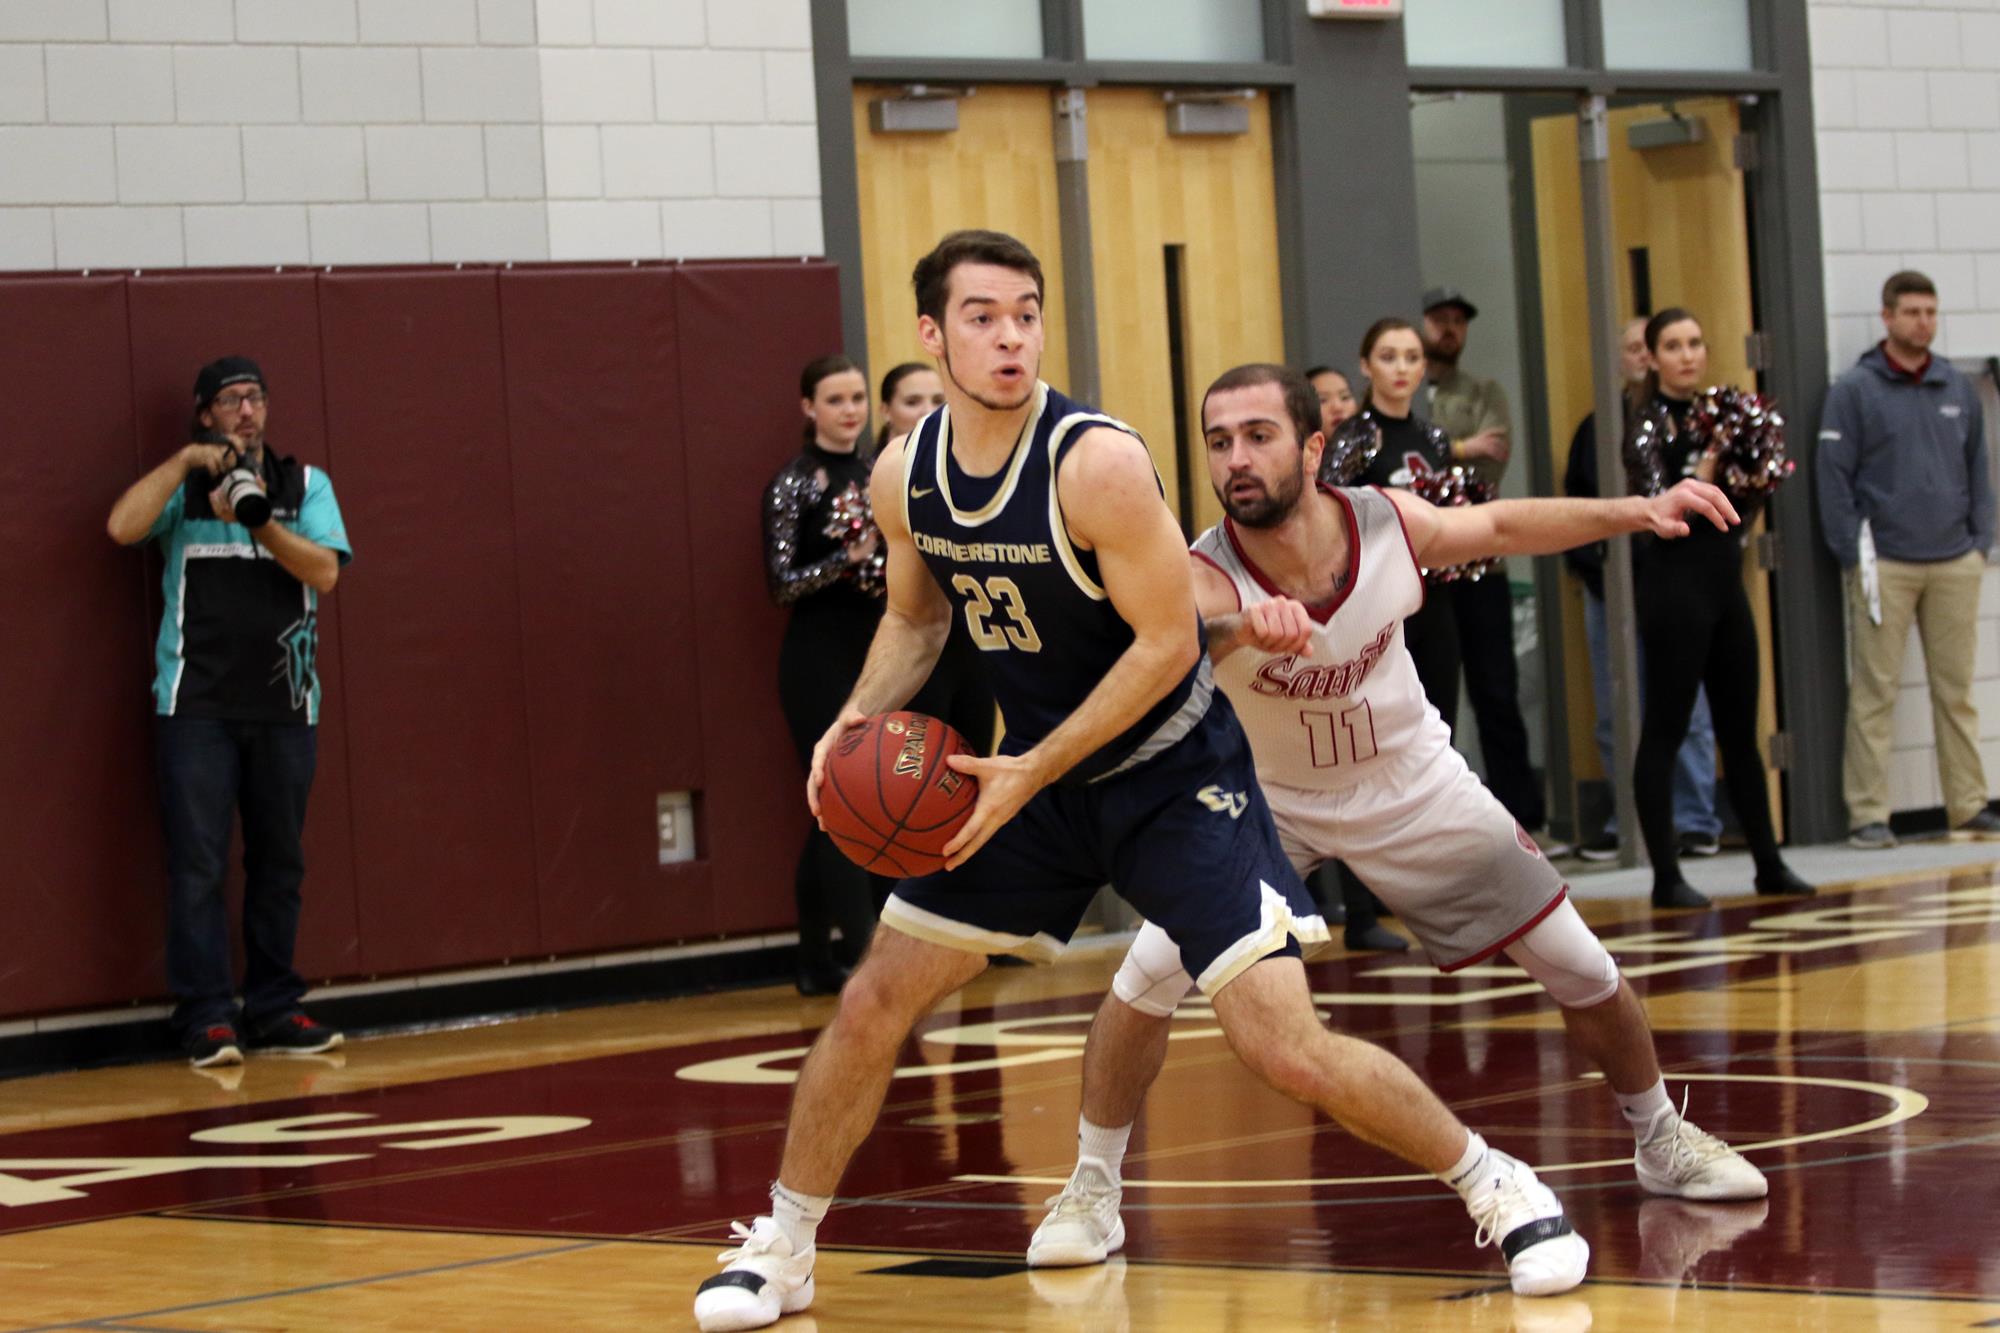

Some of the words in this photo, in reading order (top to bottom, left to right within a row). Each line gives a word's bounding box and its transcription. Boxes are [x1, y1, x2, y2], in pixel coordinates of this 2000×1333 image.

[913, 532, 1051, 565] CORNERSTONE
[952, 573, 1042, 653] 23
[1300, 697, 1378, 768] 11
